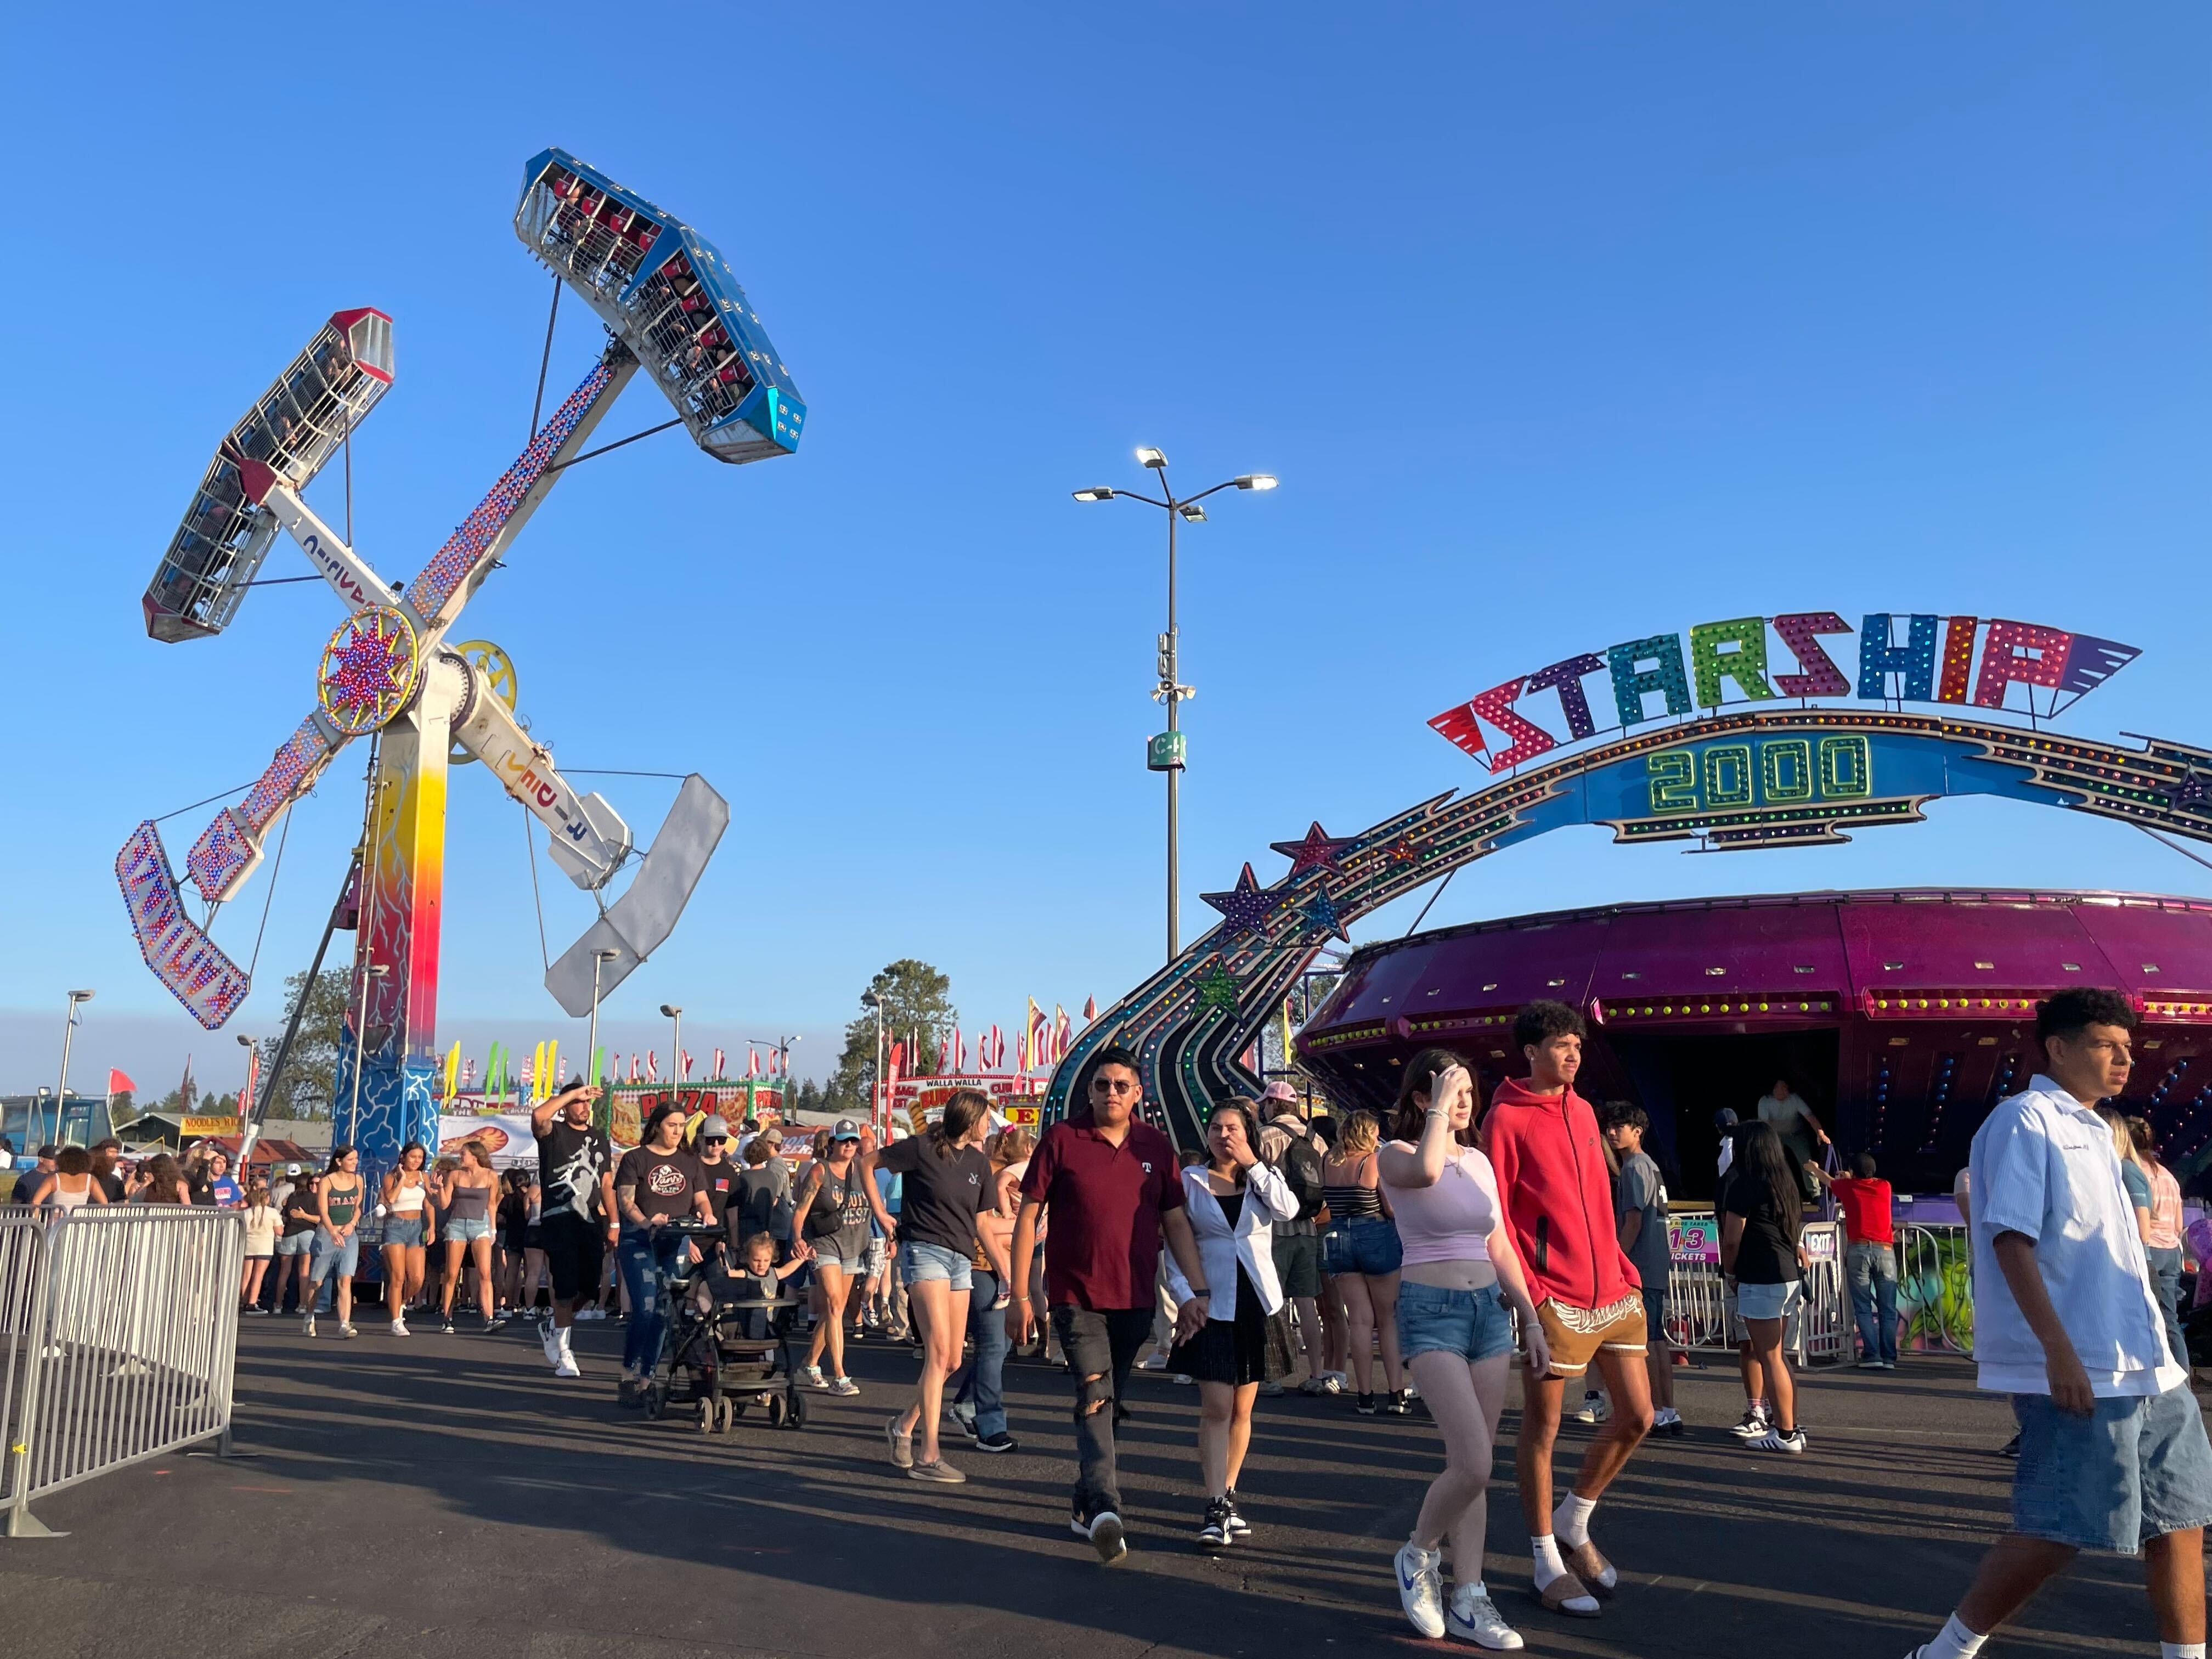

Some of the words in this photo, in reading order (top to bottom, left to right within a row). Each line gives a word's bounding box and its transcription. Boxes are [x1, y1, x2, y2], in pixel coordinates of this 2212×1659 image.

[1472, 612, 2075, 775] STARSHIP
[1647, 734, 1873, 815] 2000
[119, 829, 241, 1024] KAMIKAZE
[185, 1118, 221, 1127] NOODLES
[1669, 1228, 1706, 1251] 13
[1811, 1233, 1831, 1252] EXIT
[1671, 1252, 1707, 1261] ICKETS
